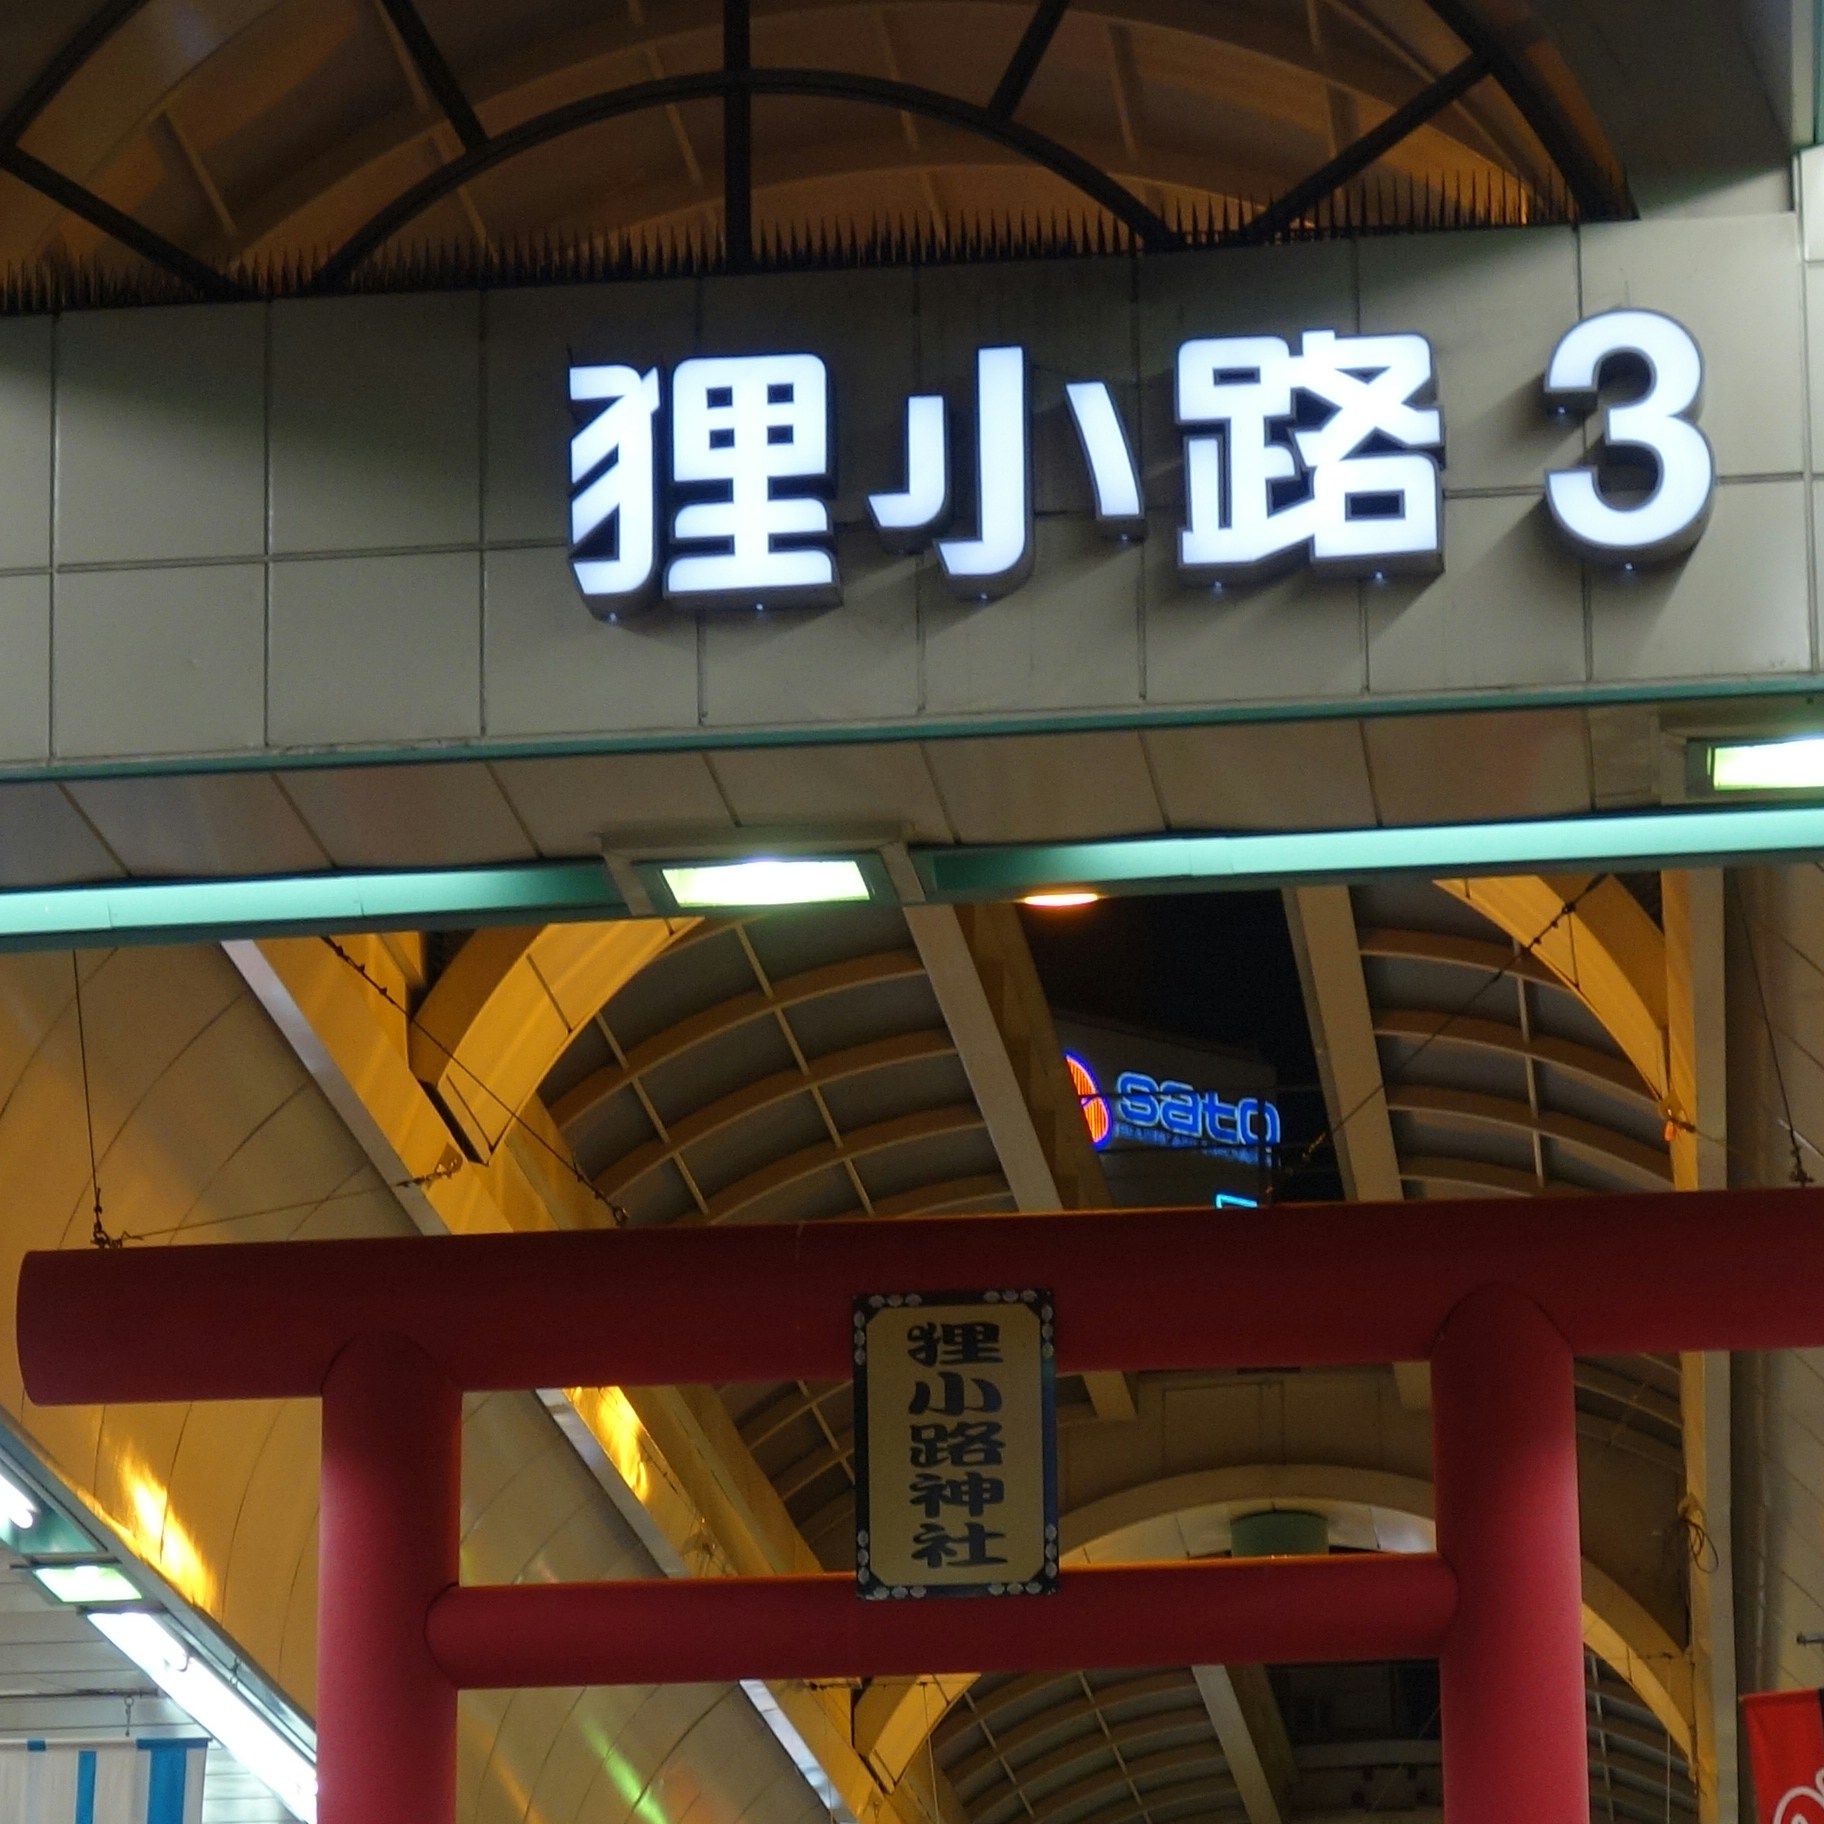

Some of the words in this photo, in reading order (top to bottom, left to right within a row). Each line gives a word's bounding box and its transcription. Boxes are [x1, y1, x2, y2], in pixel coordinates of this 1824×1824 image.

[568, 329, 1443, 602] 狸小路
[1544, 309, 1712, 553] 3
[1114, 1071, 1281, 1146] sato
[907, 1318, 1009, 1572] 狸小路神社
